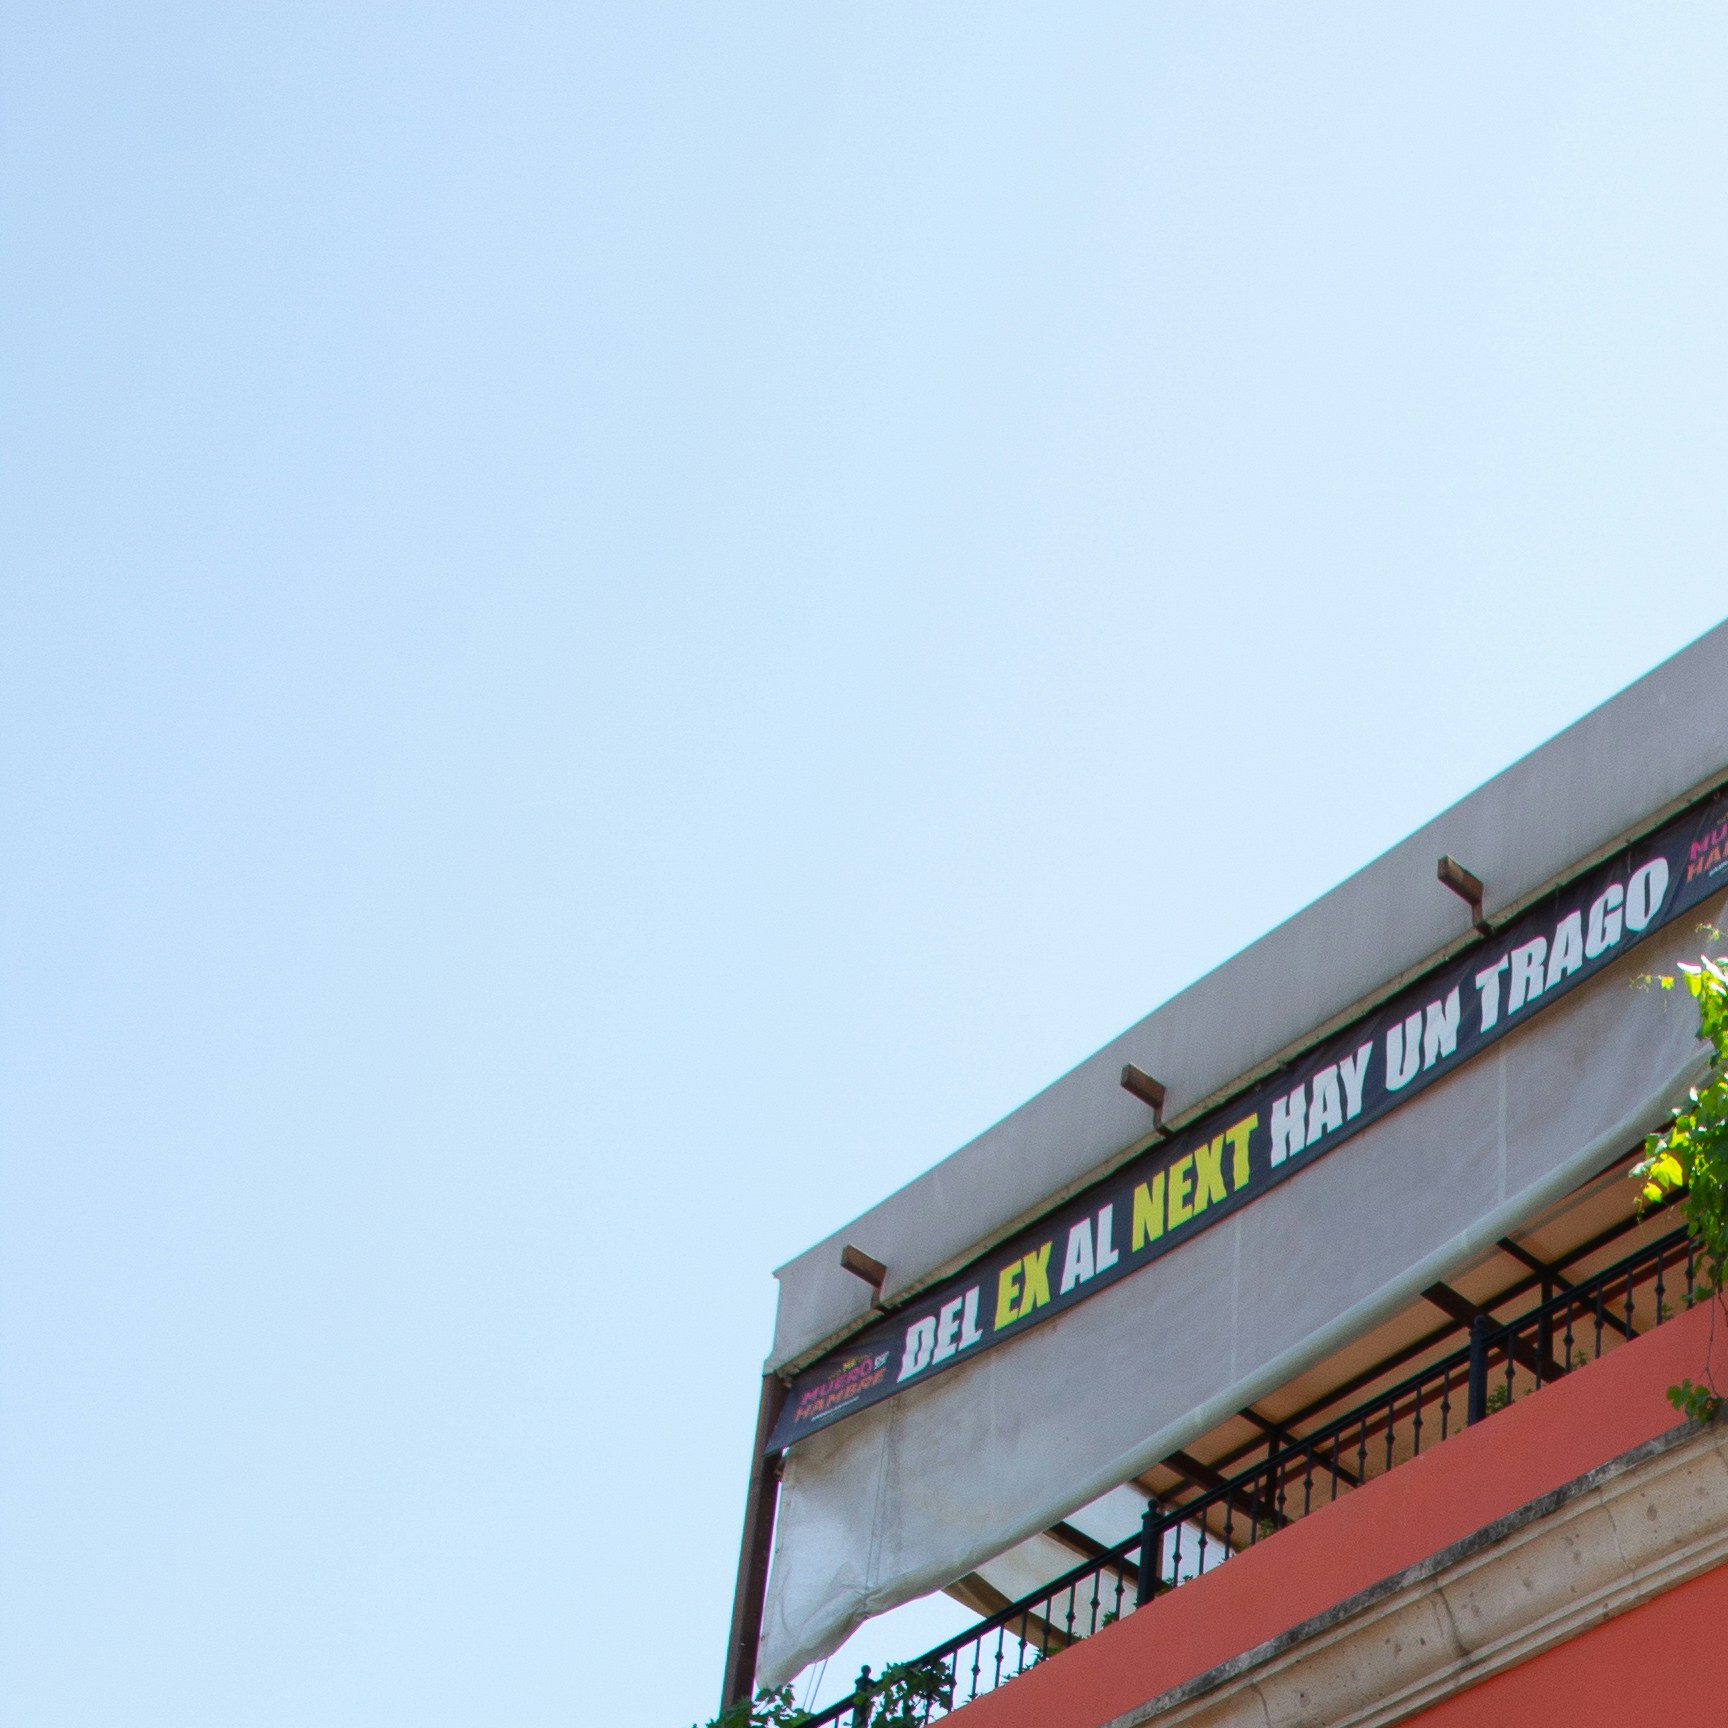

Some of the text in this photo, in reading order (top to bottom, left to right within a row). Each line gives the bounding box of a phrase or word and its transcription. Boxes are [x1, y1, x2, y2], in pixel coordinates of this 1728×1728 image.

[897, 856, 1671, 1383] DEL EX AL NEXT HAY UN TRAGO
[793, 1366, 887, 1423] HAMBRE
[799, 1359, 873, 1406] MUERO
